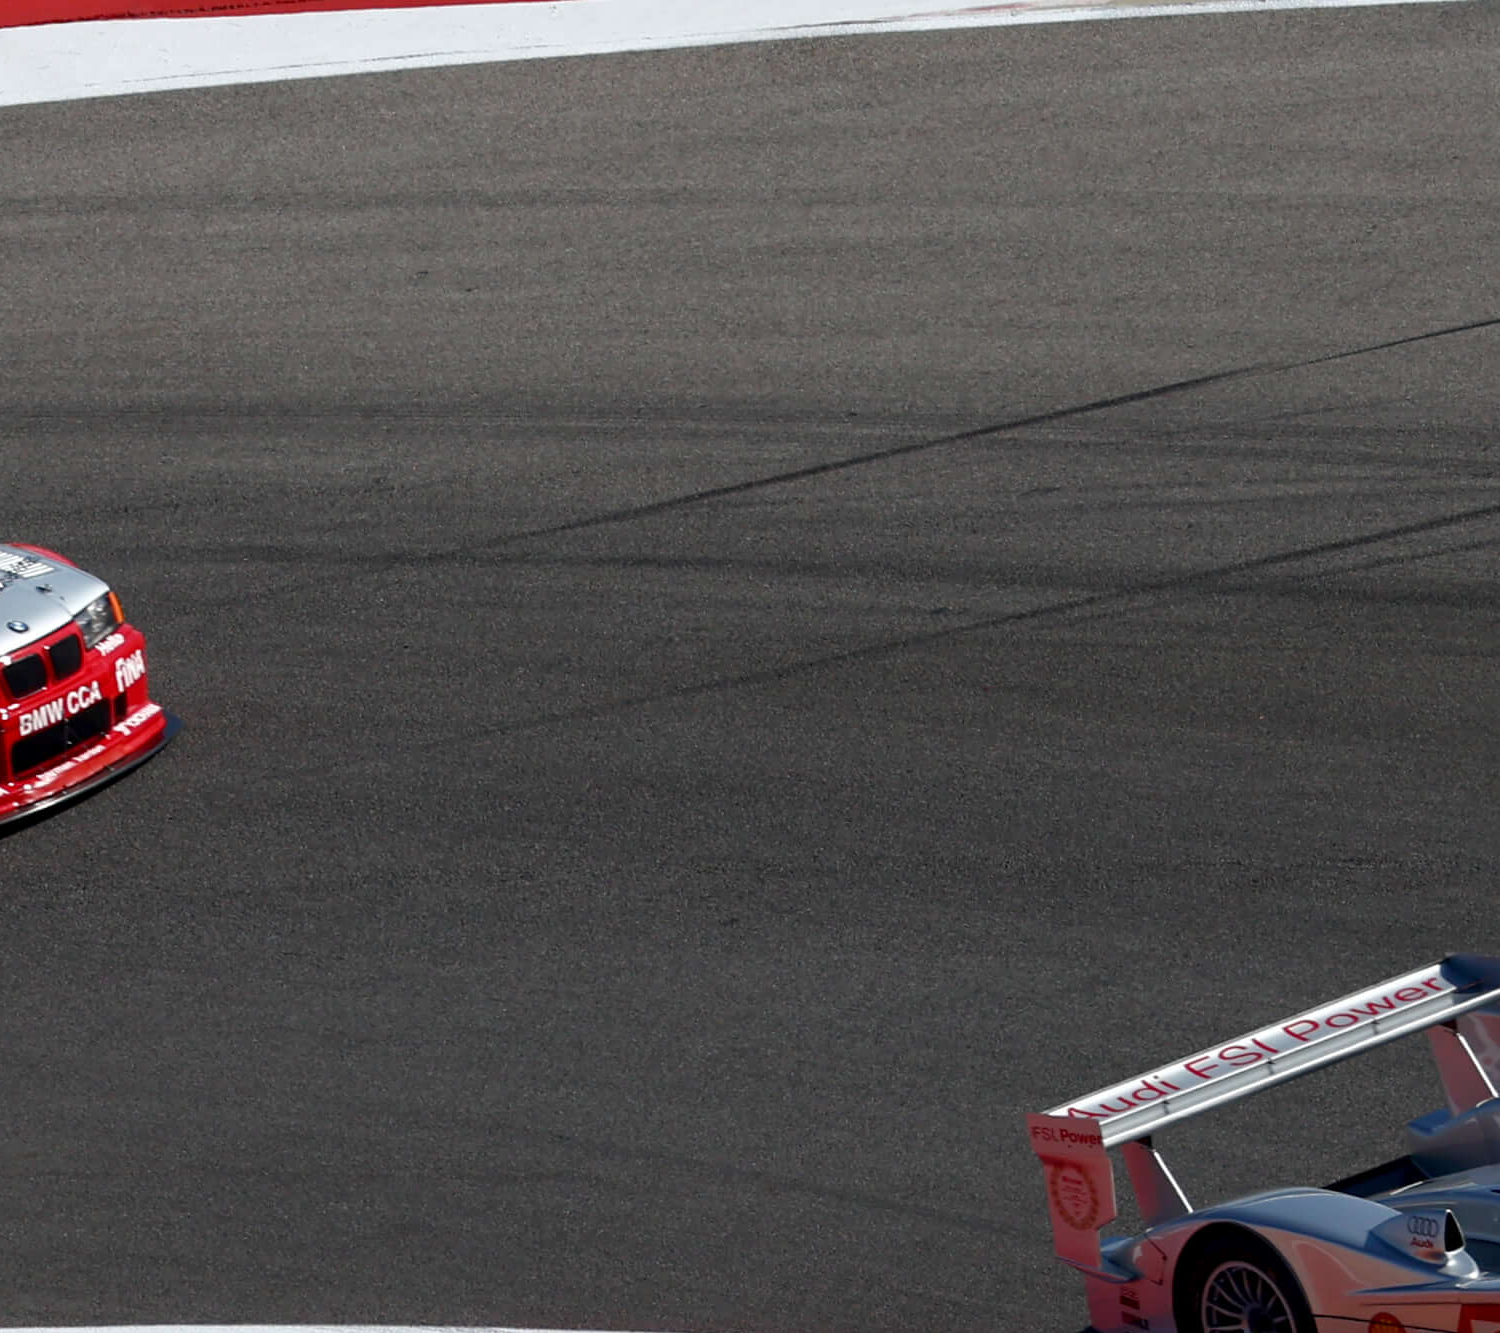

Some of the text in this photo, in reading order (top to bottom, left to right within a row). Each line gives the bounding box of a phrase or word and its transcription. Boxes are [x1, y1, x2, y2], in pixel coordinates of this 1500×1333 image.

[18, 681, 102, 736] BMW CCA
[1067, 976, 1443, 1121] Audi FSI Power
[1059, 1128, 1103, 1145] Power
